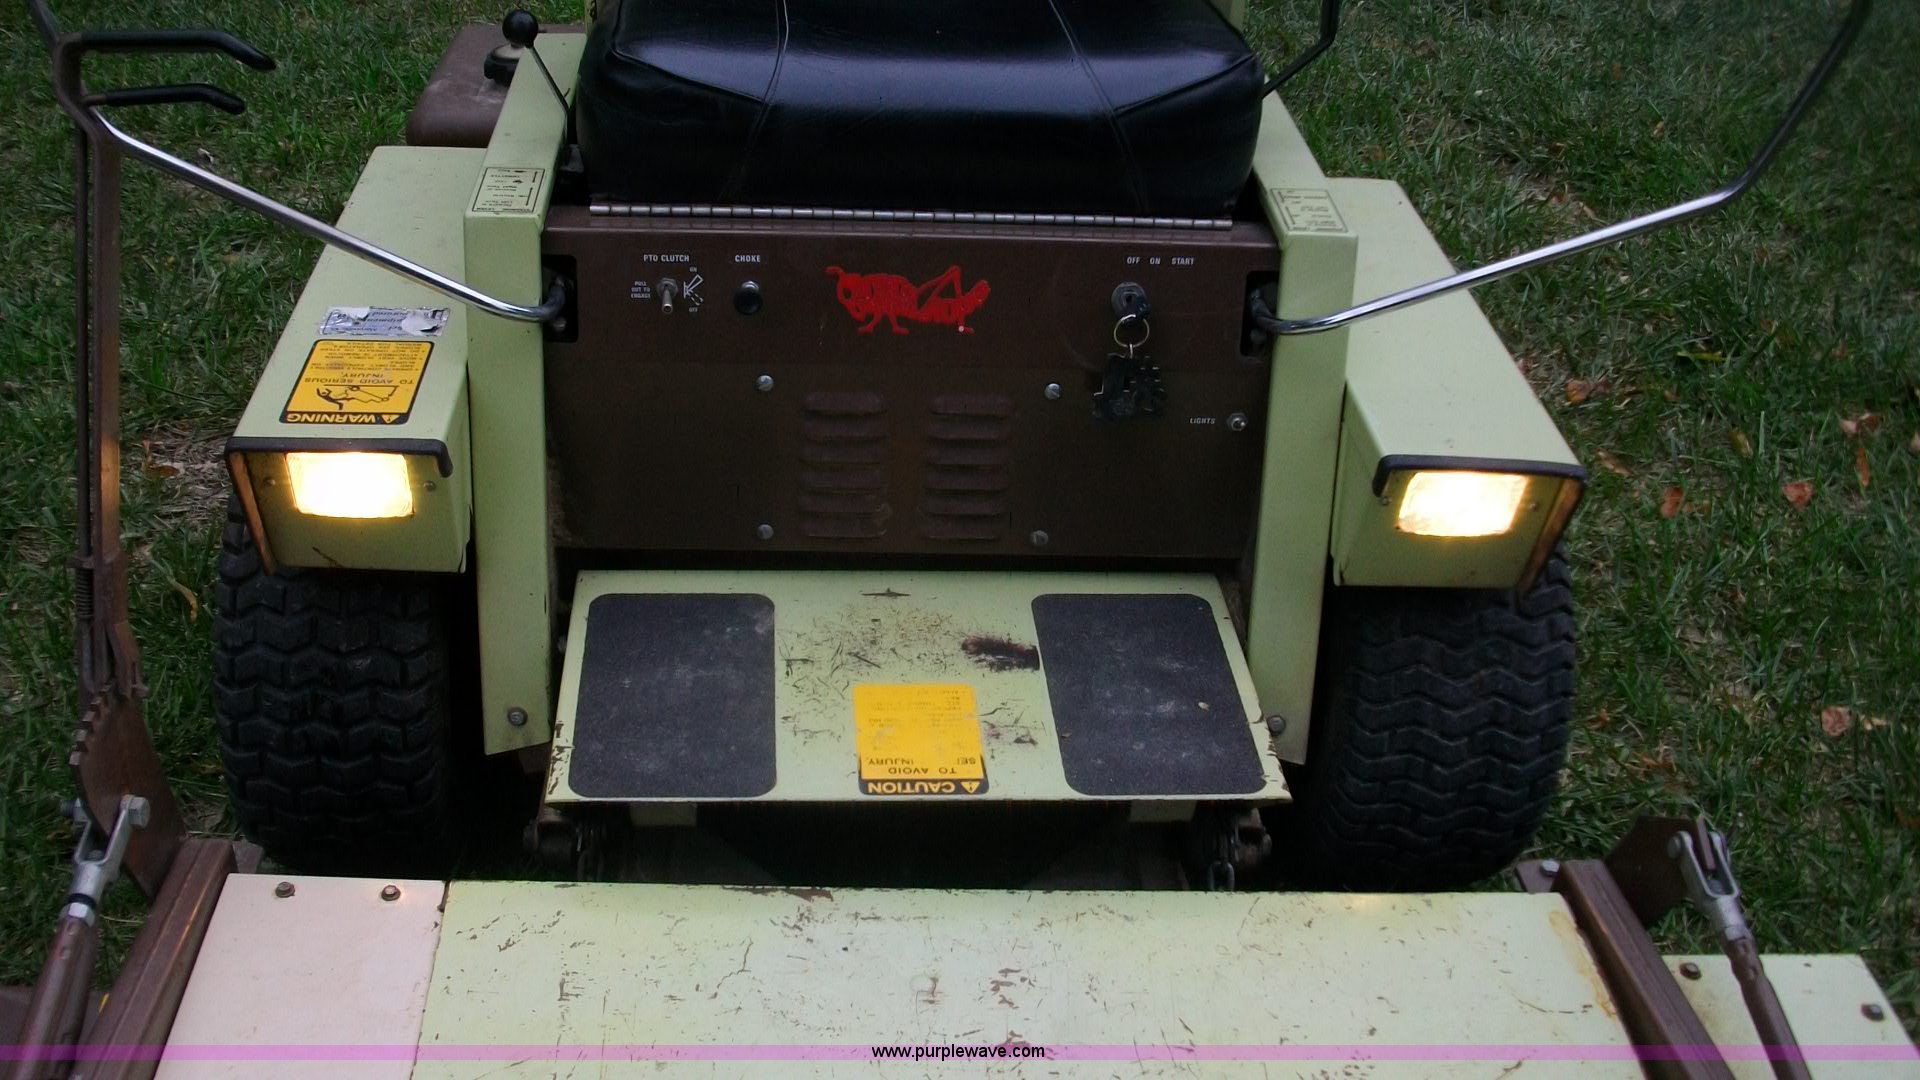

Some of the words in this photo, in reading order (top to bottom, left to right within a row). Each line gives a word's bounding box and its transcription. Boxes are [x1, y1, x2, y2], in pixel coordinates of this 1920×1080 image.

[643, 254, 658, 262] PTO
[660, 254, 690, 262] CLUTCH
[734, 254, 761, 263] CHOKE
[1126, 256, 1141, 264] OFF
[1149, 257, 1161, 265] ON
[1171, 257, 1195, 265] START
[286, 413, 378, 423] WARNING
[867, 781, 956, 793] CAUTION
